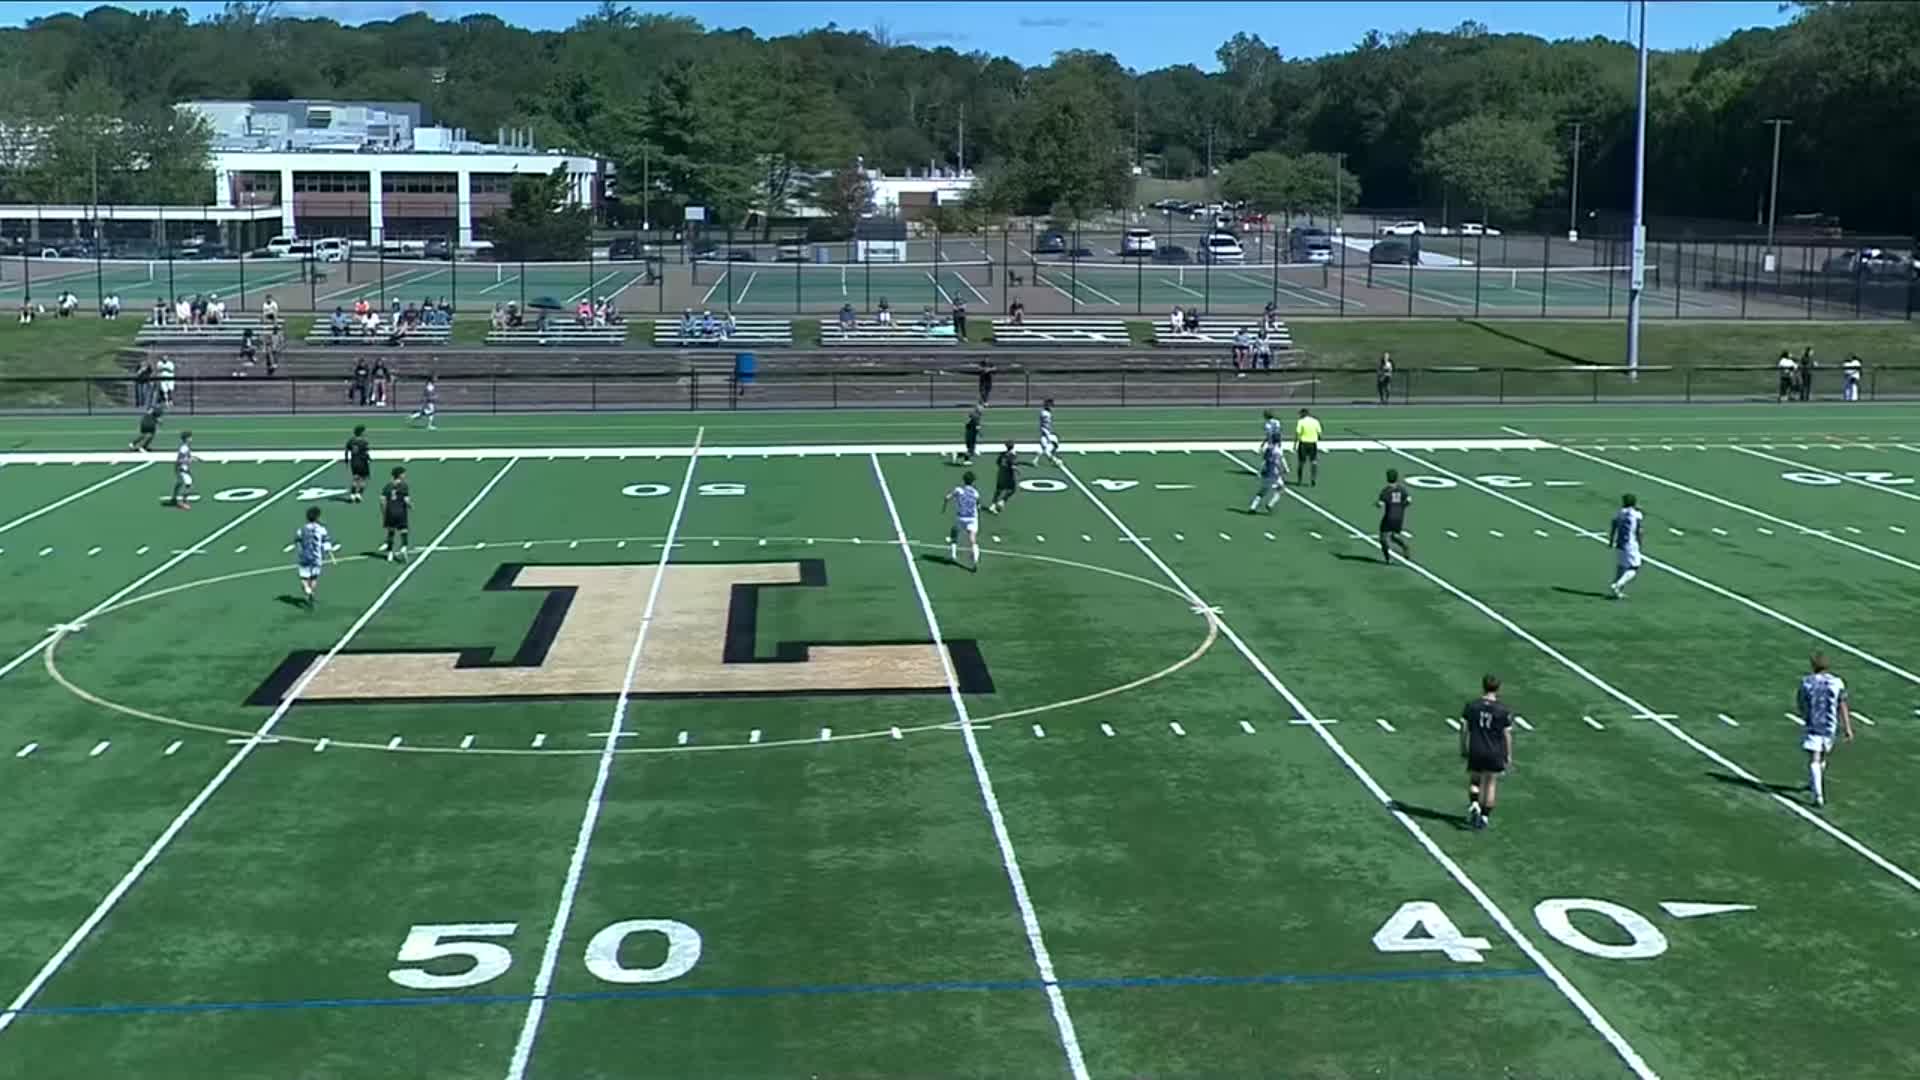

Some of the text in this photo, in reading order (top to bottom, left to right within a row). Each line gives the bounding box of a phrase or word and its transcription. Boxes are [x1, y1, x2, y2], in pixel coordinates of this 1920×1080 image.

[622, 483, 746, 496] 50
[387, 918, 702, 990] 50
[1371, 897, 1669, 963] 40
